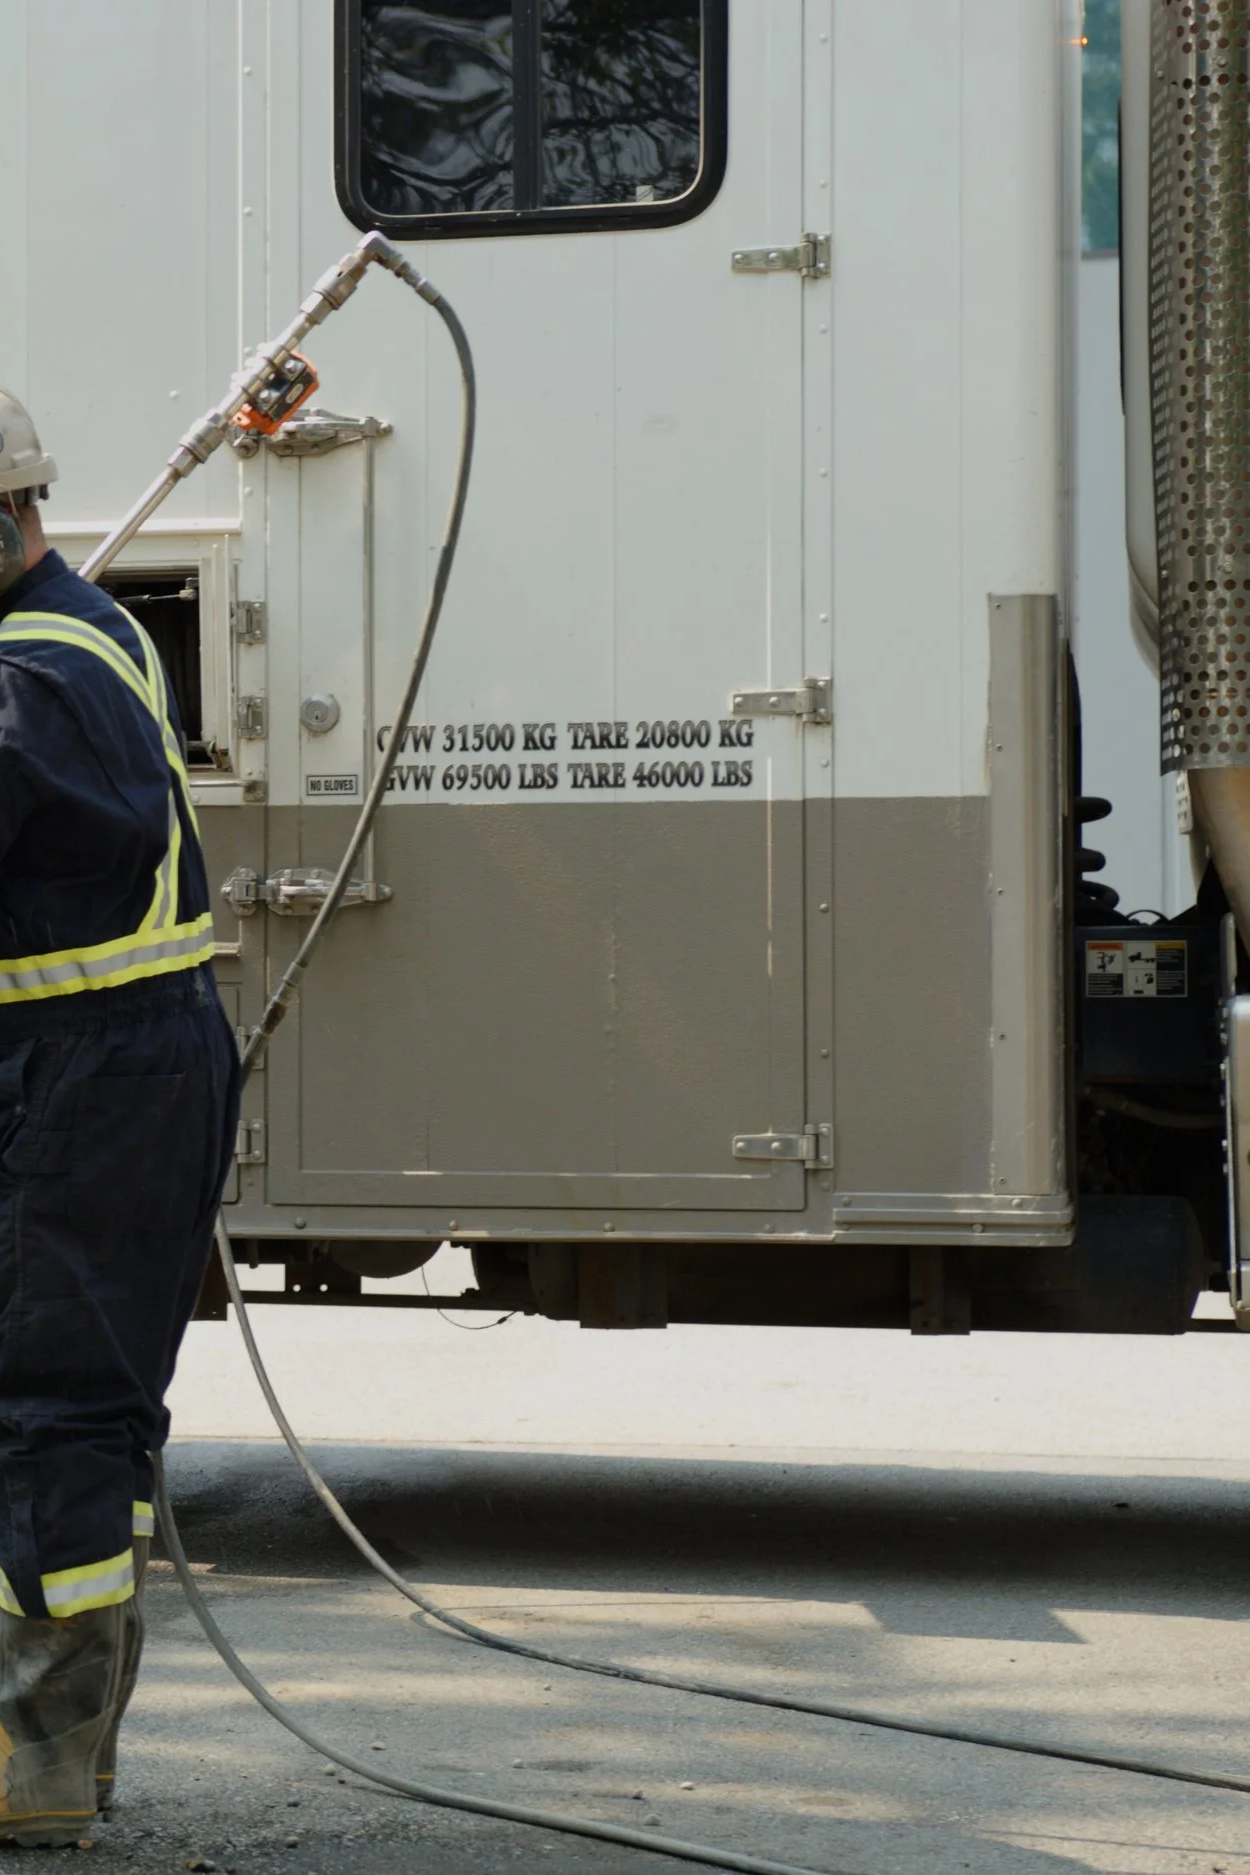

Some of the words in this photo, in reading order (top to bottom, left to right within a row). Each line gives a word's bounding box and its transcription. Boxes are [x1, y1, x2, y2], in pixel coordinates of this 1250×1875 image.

[442, 723, 515, 752] 31500
[522, 723, 557, 750] KG
[567, 722, 629, 750] TARE
[635, 720, 711, 748] 20800
[718, 719, 754, 748] KG
[310, 779, 321, 791] NO
[324, 779, 354, 791] GLOVES
[441, 763, 511, 791] 69500
[518, 763, 558, 789] LBS
[567, 762, 626, 789] TARE
[632, 761, 704, 788] 46000
[711, 760, 753, 787] LBS
